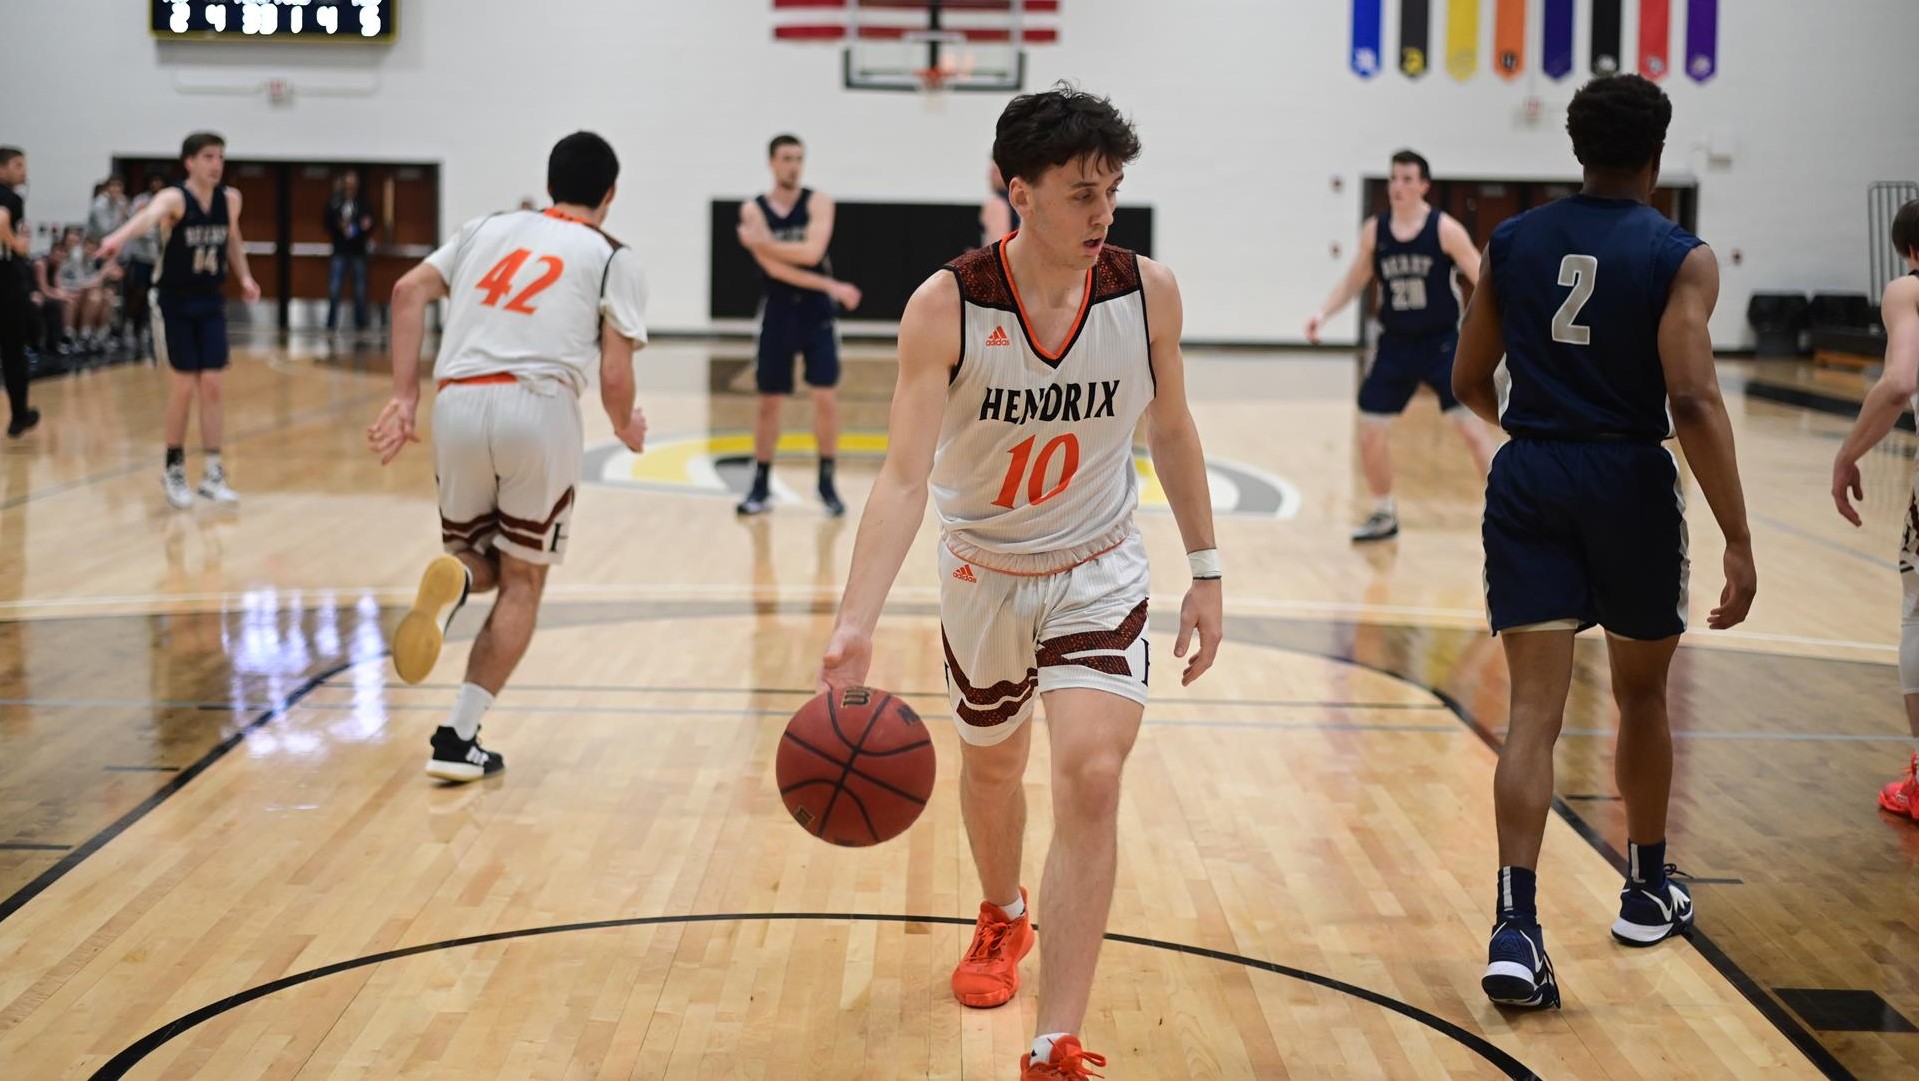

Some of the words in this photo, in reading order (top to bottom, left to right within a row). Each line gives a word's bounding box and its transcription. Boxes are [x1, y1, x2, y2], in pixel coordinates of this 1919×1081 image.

[475, 247, 564, 316] 42
[1551, 253, 1598, 345] 2
[978, 379, 1121, 426] HENDRIX
[991, 433, 1080, 510] 10
